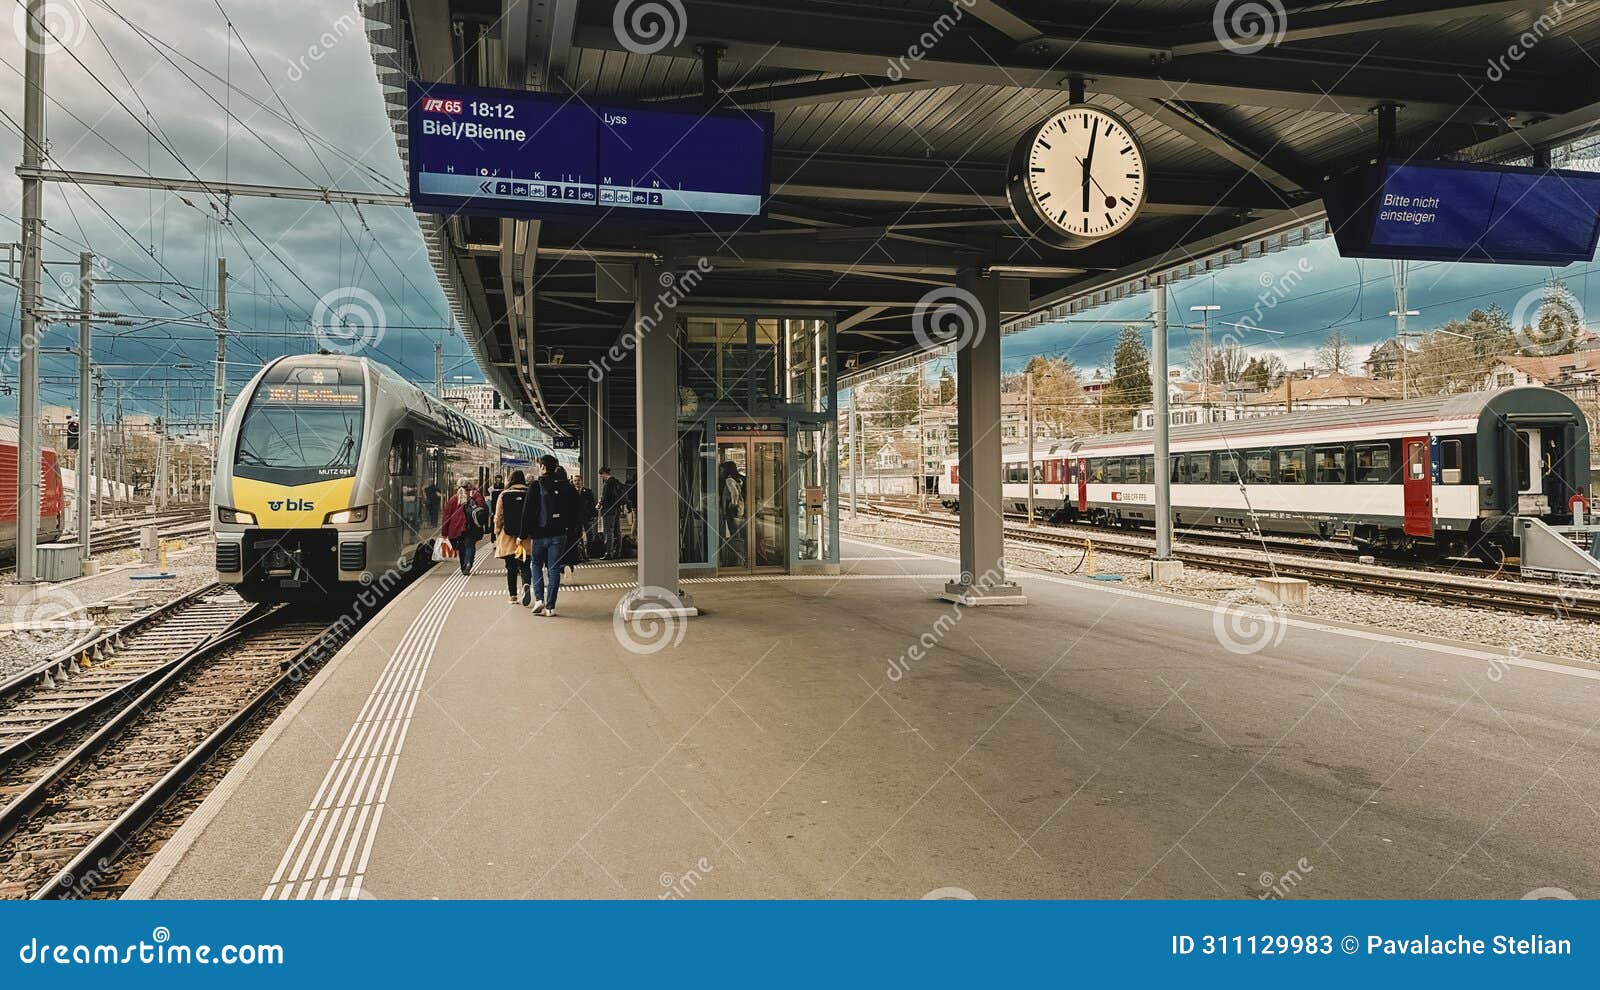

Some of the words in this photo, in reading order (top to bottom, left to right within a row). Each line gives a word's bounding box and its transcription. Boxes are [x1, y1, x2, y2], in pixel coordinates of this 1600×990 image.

[424, 99, 443, 111] IR
[445, 101, 461, 113] 65
[470, 101, 515, 119] 18:12
[604, 112, 628, 126] Lyss
[422, 119, 526, 142] Biel/Bienne
[447, 165, 454, 173] H
[491, 169, 497, 177] J
[534, 171, 541, 179] K
[568, 174, 575, 182] L
[603, 176, 612, 185] M
[652, 180, 660, 188] N
[500, 184, 506, 193] 2
[551, 188, 558, 196] 2
[568, 189, 575, 197] 2
[653, 195, 659, 203] 2
[1383, 193, 1410, 207] Bitte
[1412, 196, 1440, 209] nicht
[1380, 209, 1436, 225] einsteigen
[1431, 437, 1438, 445] 2
[286, 498, 315, 511] bls
